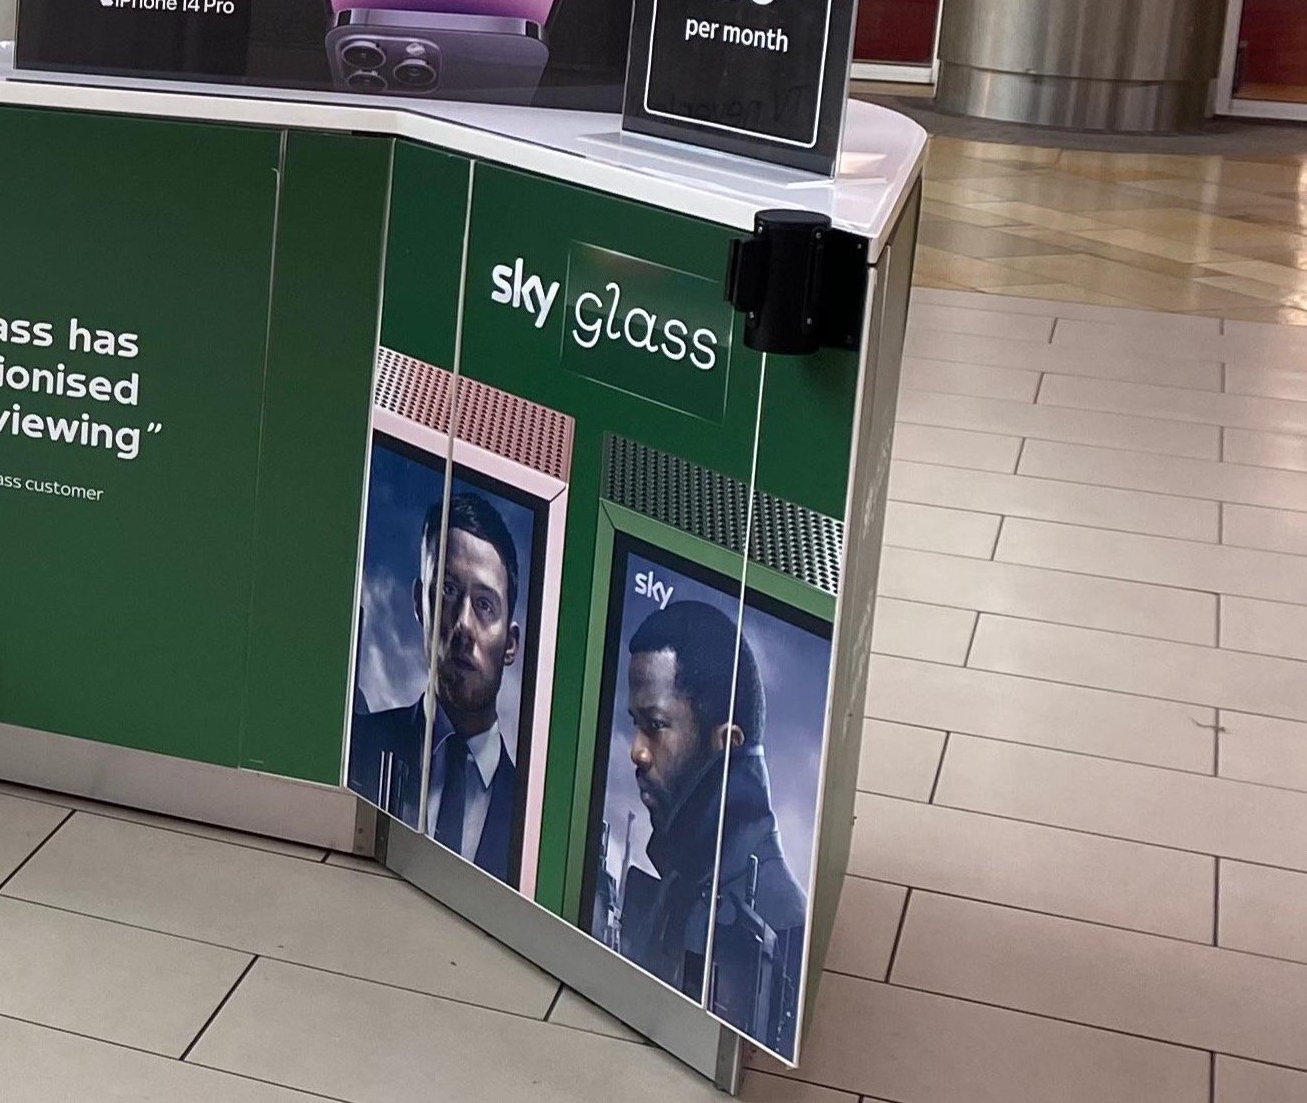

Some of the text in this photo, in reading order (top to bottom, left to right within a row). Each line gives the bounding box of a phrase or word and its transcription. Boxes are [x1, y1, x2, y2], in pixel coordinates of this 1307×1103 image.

[685, 17, 789, 53] per month
[491, 257, 718, 370] sky glass
[69, 318, 139, 358] has
[25, 476, 104, 502] customer
[634, 570, 674, 610] sky
